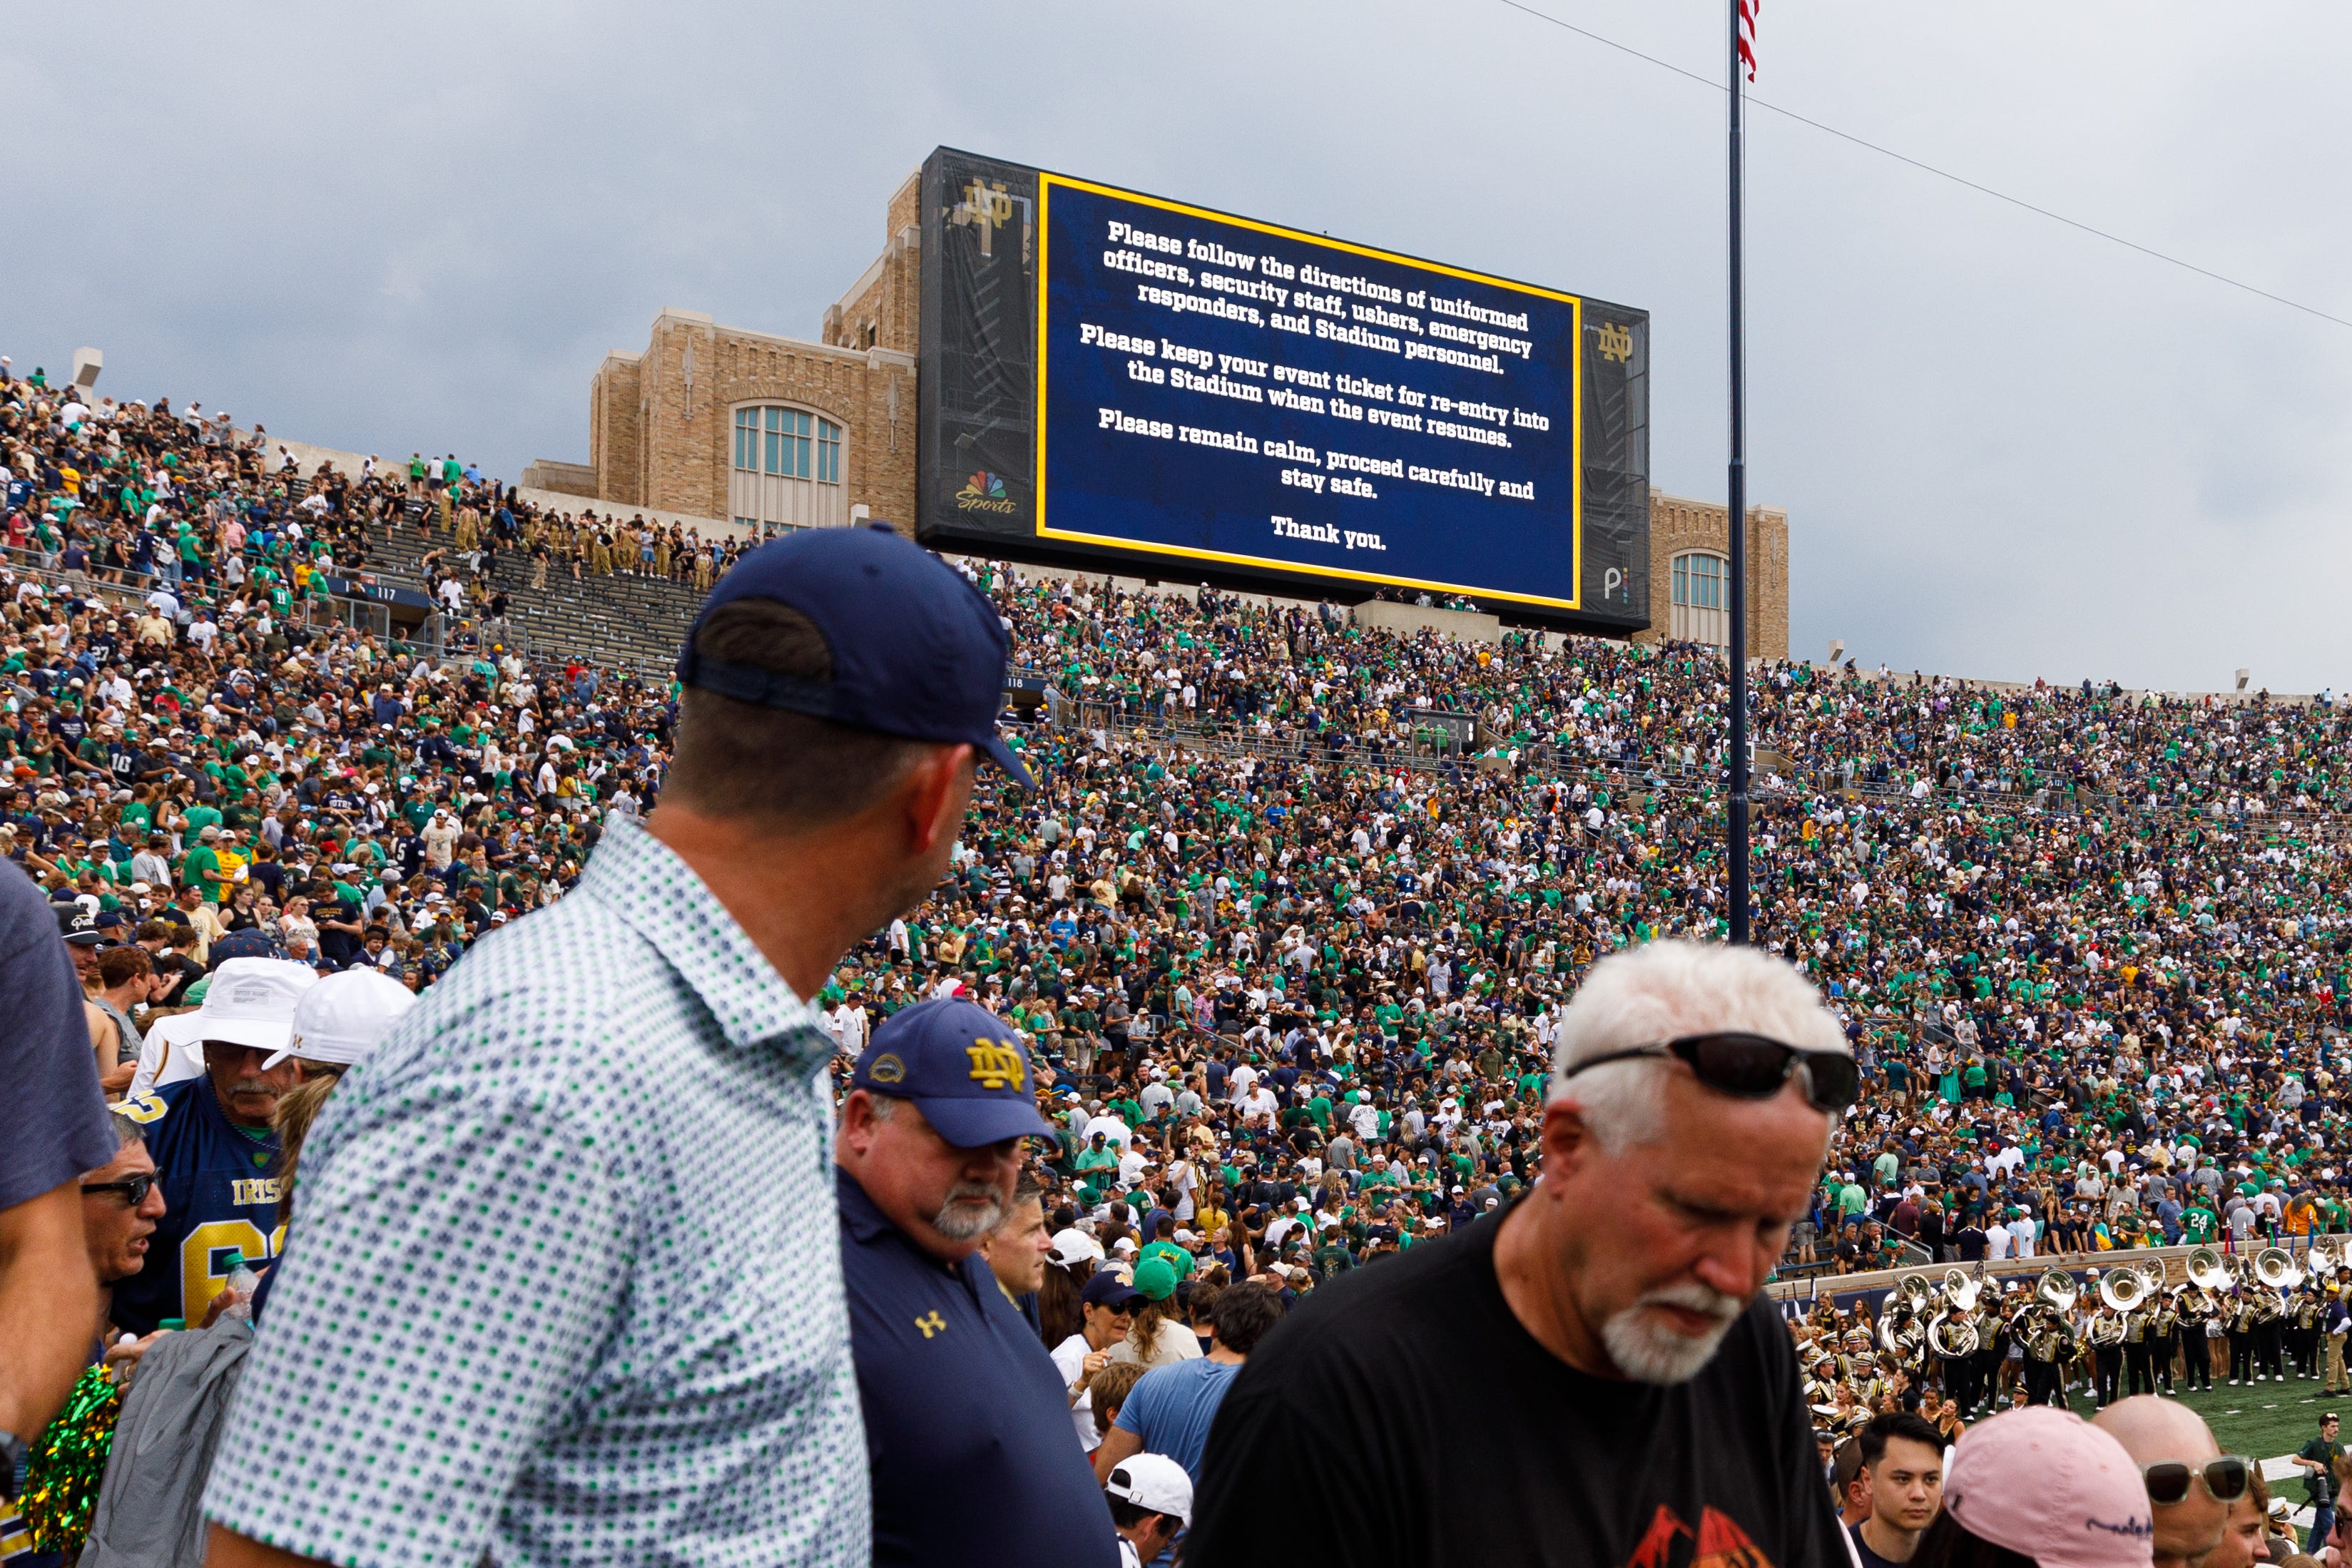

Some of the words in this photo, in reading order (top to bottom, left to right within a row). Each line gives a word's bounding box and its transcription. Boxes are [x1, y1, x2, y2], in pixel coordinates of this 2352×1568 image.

[1108, 220, 1183, 255] Please
[1187, 238, 1256, 271] follow
[1260, 255, 1295, 280] the
[1300, 264, 1402, 304] directions
[1406, 290, 1426, 310] of
[1430, 296, 1529, 332] uniformed
[1103, 249, 1195, 287] officers,
[1200, 271, 1289, 308] security
[1293, 291, 1347, 320] staff,
[1351, 304, 1425, 337] ushers,
[1429, 321, 1533, 360] emergency
[1137, 284, 1266, 329] responders,
[1270, 312, 1311, 335] and
[1315, 318, 1401, 354] Stadium
[1404, 340, 1505, 375] personnel.
[1079, 322, 1156, 357] Please
[1161, 337, 1213, 370] keep
[1218, 353, 1269, 378] your
[1273, 365, 1331, 390] event
[1335, 374, 1394, 402] ticket
[1398, 385, 1427, 408] for
[1430, 394, 1510, 427] re-entry
[1512, 407, 1549, 432] into
[1127, 360, 1165, 385] the
[1170, 367, 1263, 403] Stadium
[1267, 387, 1325, 414] when
[1329, 397, 1363, 421] the
[1368, 408, 1422, 432] event
[1426, 419, 1512, 449] resumes.
[1098, 407, 1174, 439] Please
[1178, 425, 1259, 454] remain
[1263, 439, 1322, 467] calm,
[1325, 451, 1405, 479] proceed
[1408, 465, 1496, 497] carefully
[1499, 481, 1535, 500] and
[1281, 468, 1326, 494] stay
[1330, 477, 1378, 499] safe.
[955, 490, 1016, 513] Sports
[1271, 515, 1340, 544] Thank
[1343, 530, 1387, 551] you.
[378, 586, 396, 601] 117
[91, 646, 109, 661] 27
[1007, 678, 1023, 688] 118
[111, 753, 132, 773] 10
[397, 842, 407, 861] 5
[1405, 878, 1412, 887] 7
[966, 1037, 1025, 1093] ND
[232, 1178, 282, 1206] IRIS
[2191, 1212, 2208, 1228] 24
